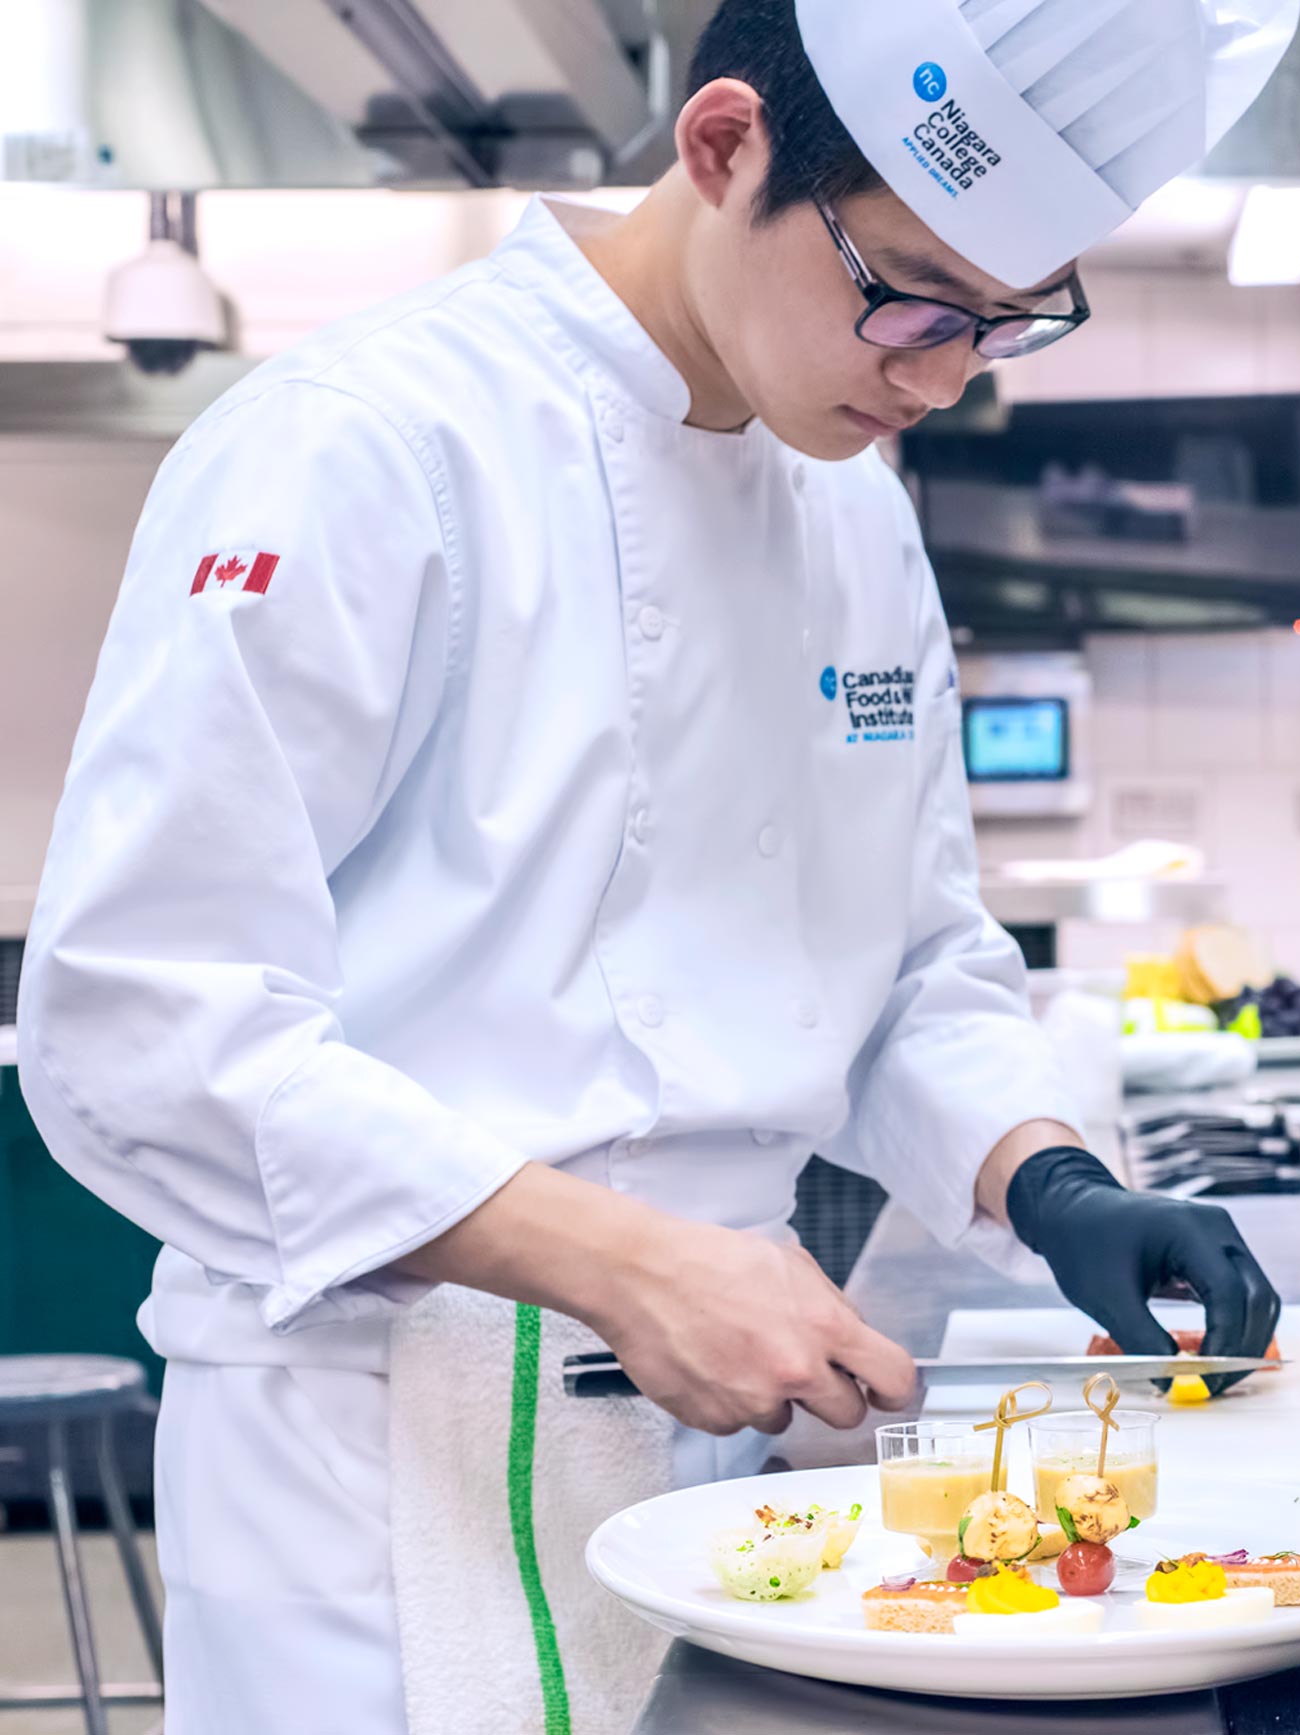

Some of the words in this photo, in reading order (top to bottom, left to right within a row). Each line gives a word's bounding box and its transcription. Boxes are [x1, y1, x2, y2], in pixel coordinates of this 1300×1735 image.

[919, 67, 940, 95] nc
[914, 123, 973, 190] Canada
[927, 111, 987, 178] College
[941, 98, 1001, 166] Niagara
[845, 687, 892, 708] Food
